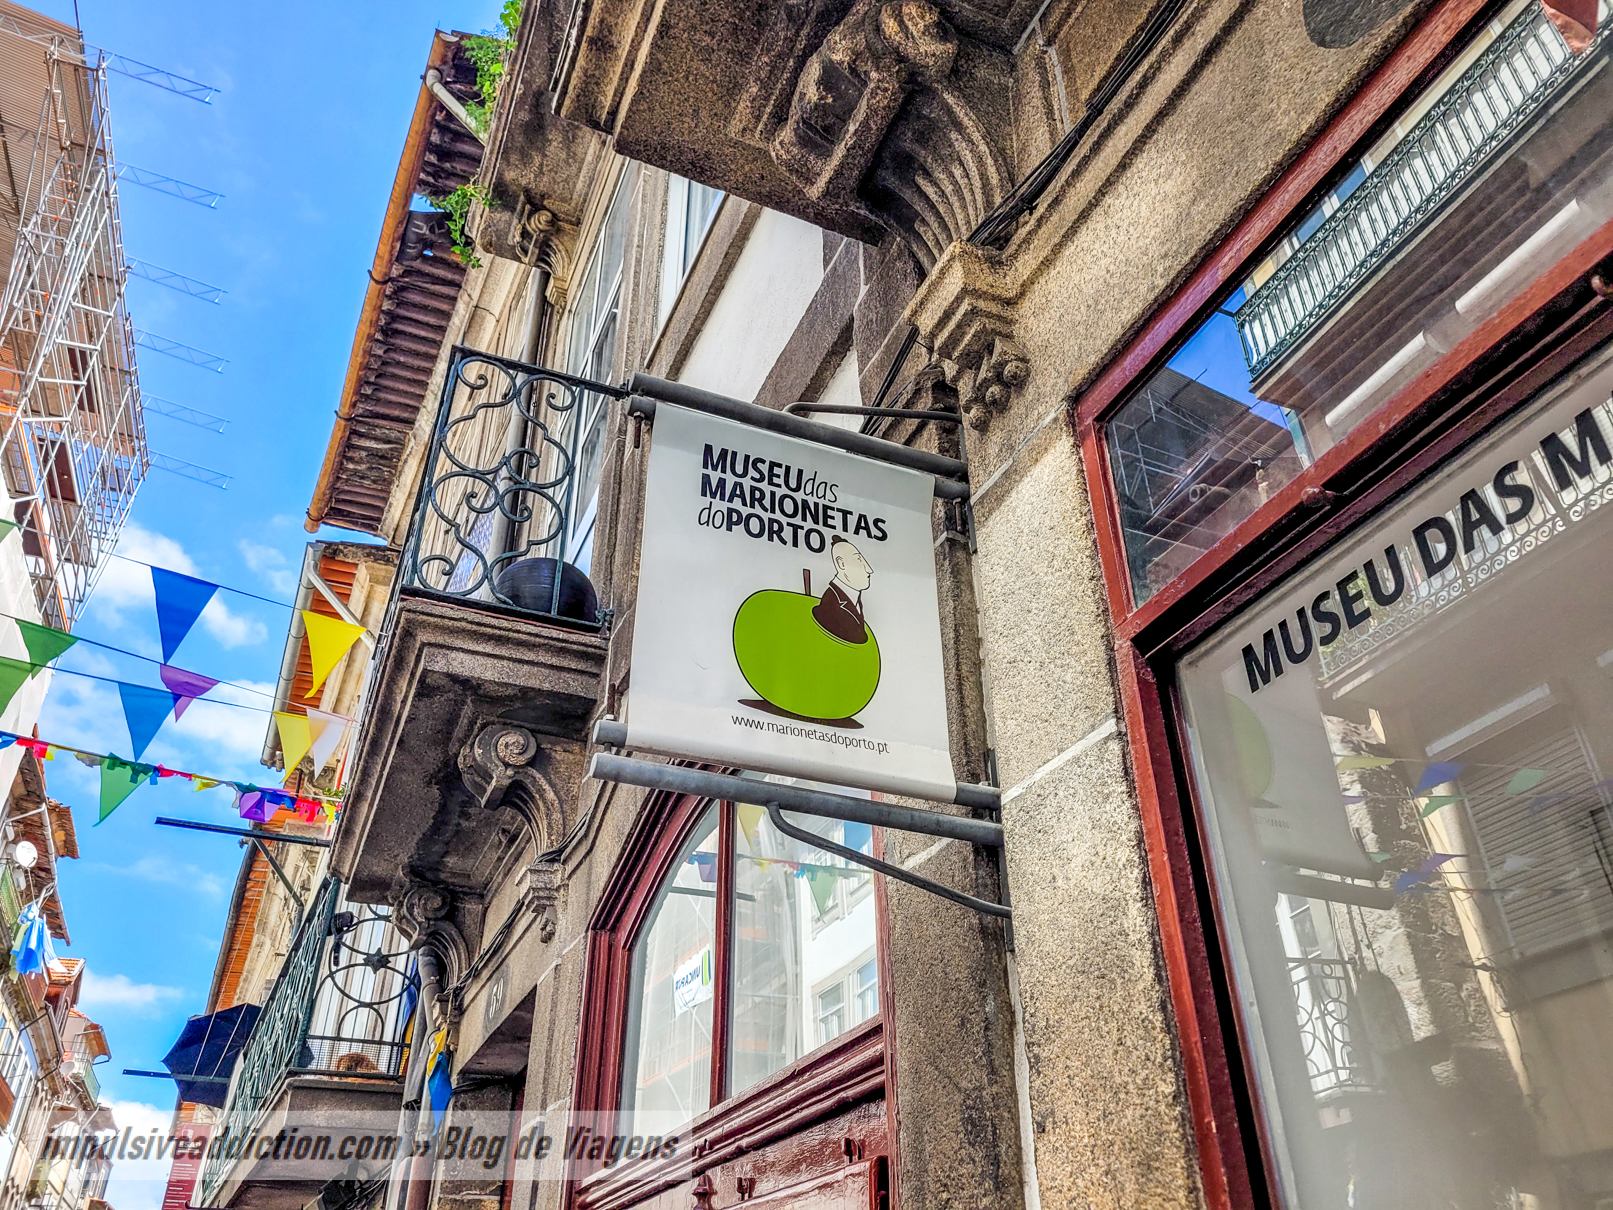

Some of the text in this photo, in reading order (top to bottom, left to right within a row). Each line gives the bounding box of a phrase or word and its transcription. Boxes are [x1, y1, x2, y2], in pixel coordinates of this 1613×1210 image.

[700, 473, 888, 541] MARIONETAS
[1241, 398, 1613, 694] MUSEU DAS M
[731, 715, 890, 754] www.marionetasdoporto.pt
